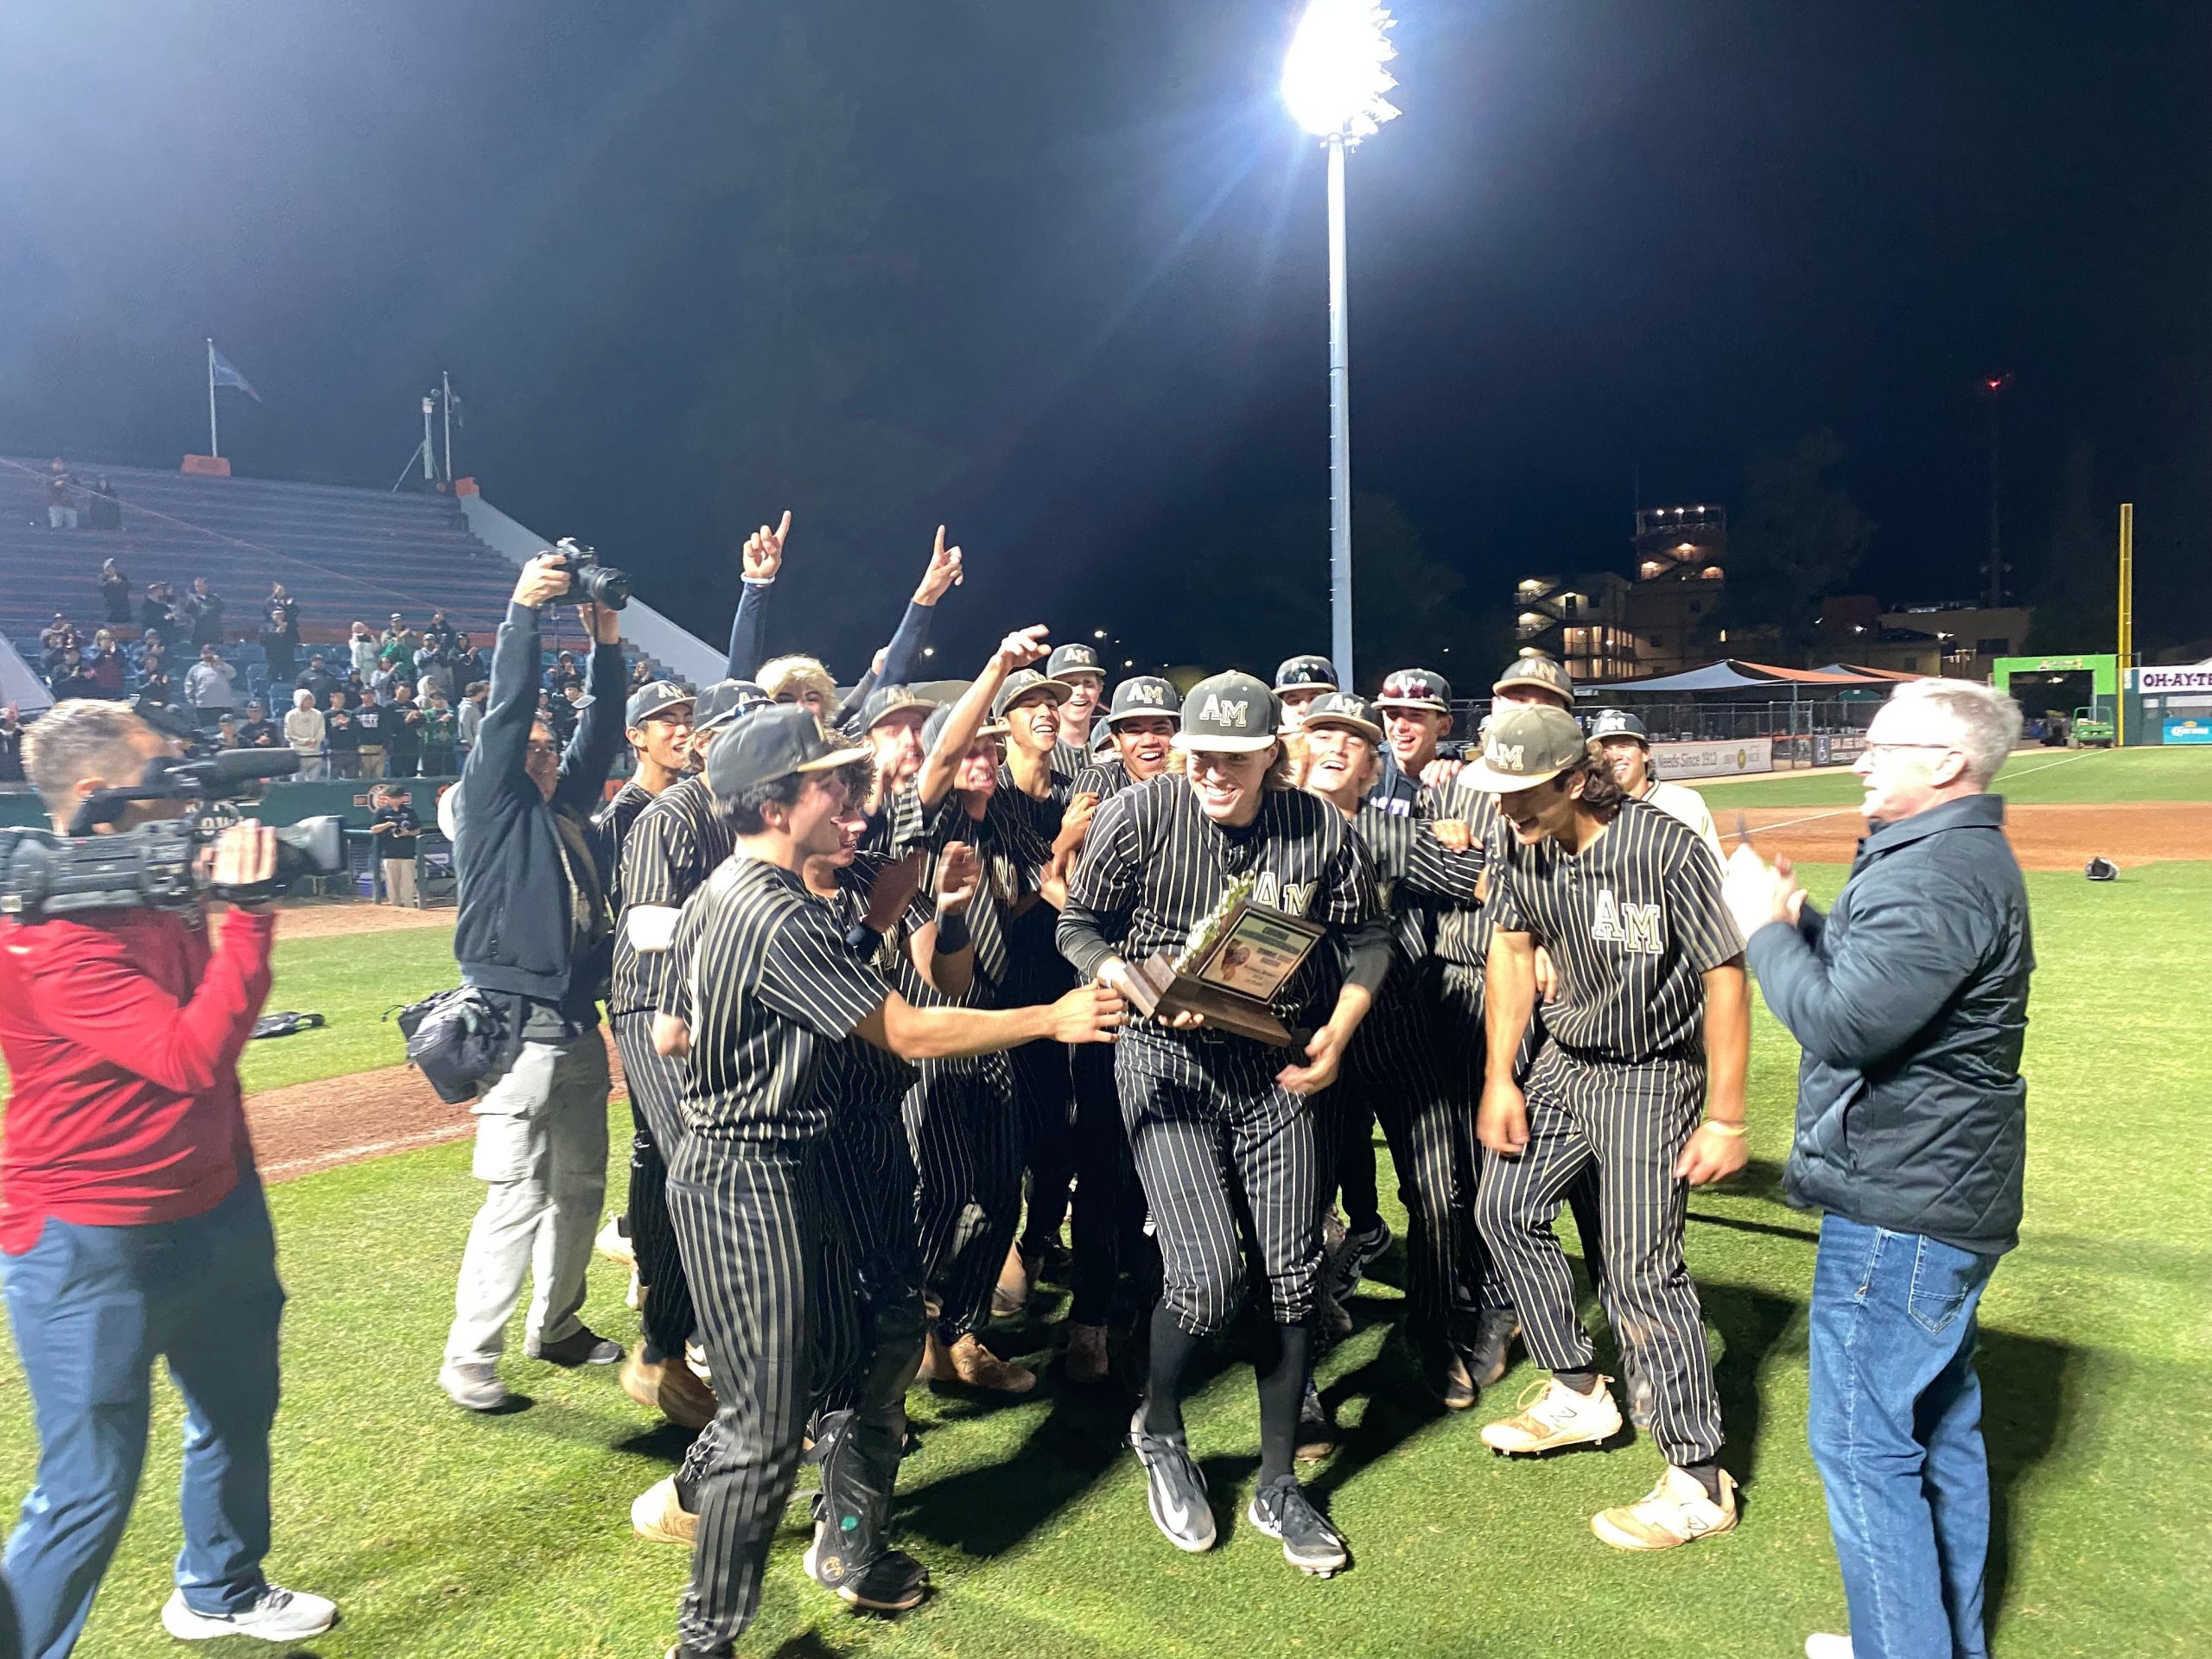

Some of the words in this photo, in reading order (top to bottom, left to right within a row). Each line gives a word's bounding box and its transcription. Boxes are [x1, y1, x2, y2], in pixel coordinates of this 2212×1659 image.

[1063, 648, 1090, 664] AM
[1519, 659, 1556, 685] AM
[1126, 682, 1164, 705] AM
[1325, 694, 1365, 718] AM
[1199, 694, 1249, 728] AM
[1484, 734, 1524, 771] AM
[1656, 753, 1680, 768] Needs
[1680, 753, 1700, 767] Since
[1701, 751, 1718, 766] 1912
[1253, 871, 1319, 918] AM
[1591, 889, 1664, 955] AM
